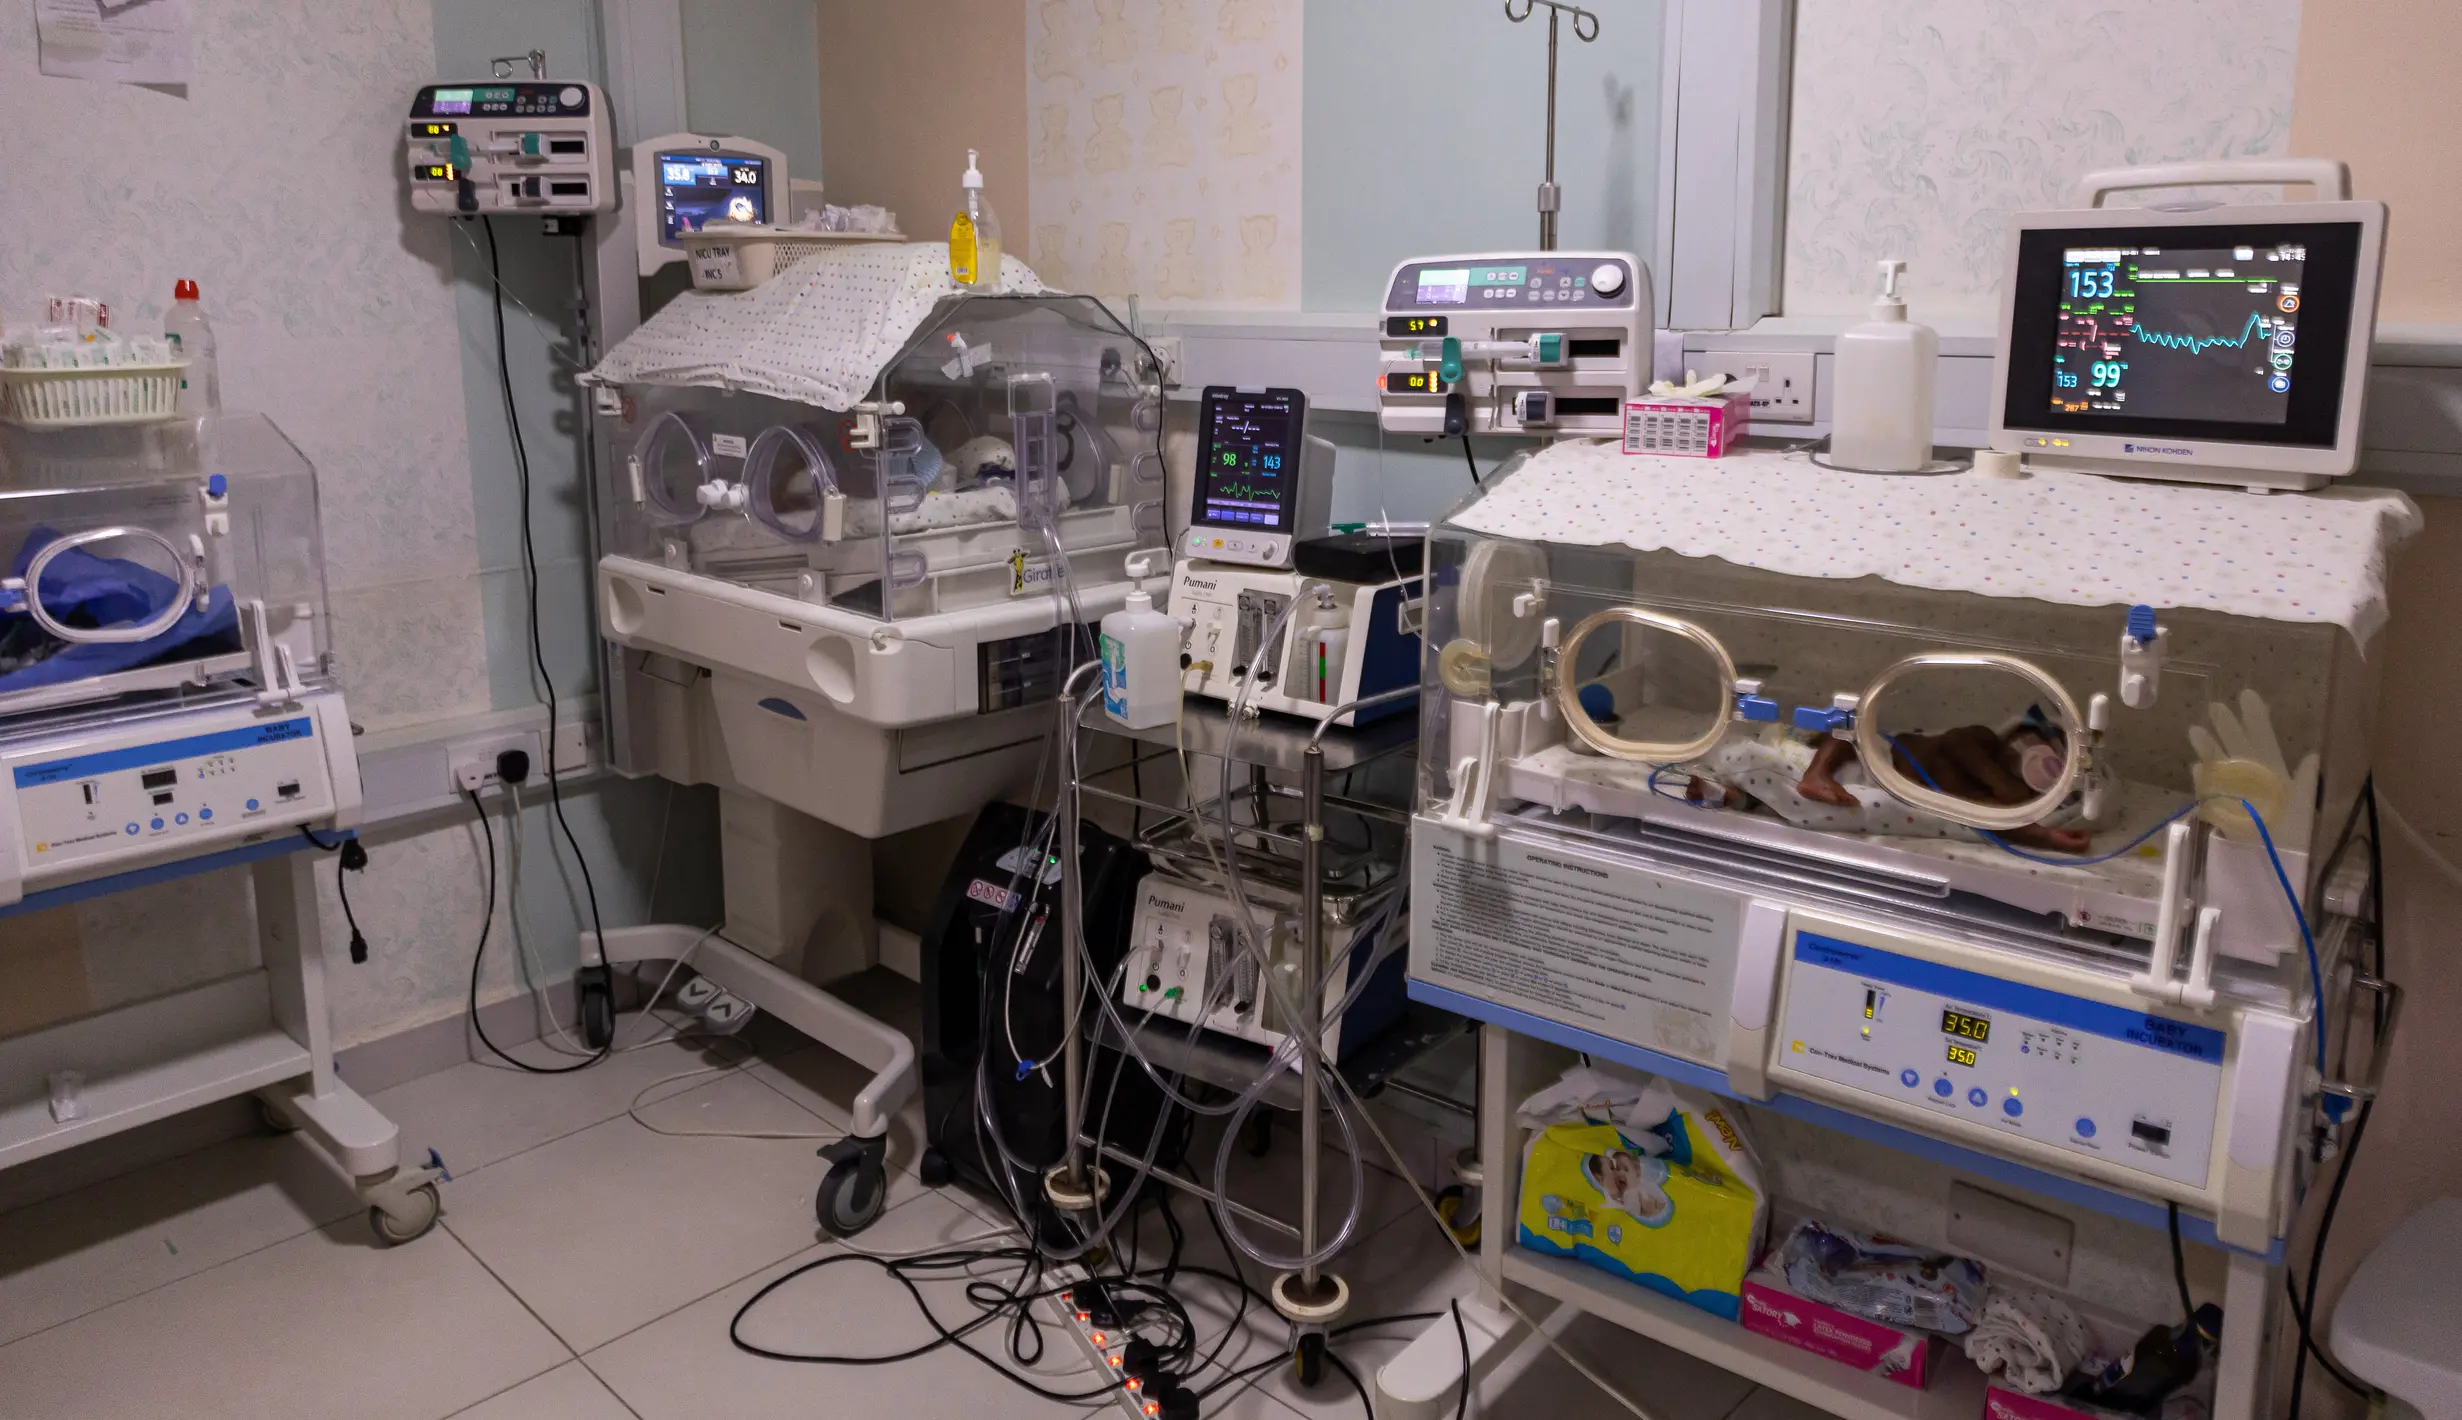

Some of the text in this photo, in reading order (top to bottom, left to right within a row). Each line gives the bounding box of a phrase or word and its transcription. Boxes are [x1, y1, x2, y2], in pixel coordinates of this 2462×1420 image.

[2069, 269, 2114, 298] 153
[2057, 374, 2078, 388] 153
[2091, 361, 2121, 388] 99
[1223, 453, 1237, 466] 98
[2136, 446, 2194, 456] NIHON KOHDEN
[1263, 455, 1281, 470] 143
[1023, 564, 1065, 583] Girafe
[1183, 575, 1218, 591] Pumani
[1148, 895, 1185, 912] Pumani
[1944, 1014, 1988, 1040] 35.0
[2145, 1015, 2187, 1039] BABY
[2125, 1028, 2203, 1056] INCUBATOR
[1948, 1047, 1975, 1065] 35.0
[1752, 1302, 1784, 1319] SATORY
